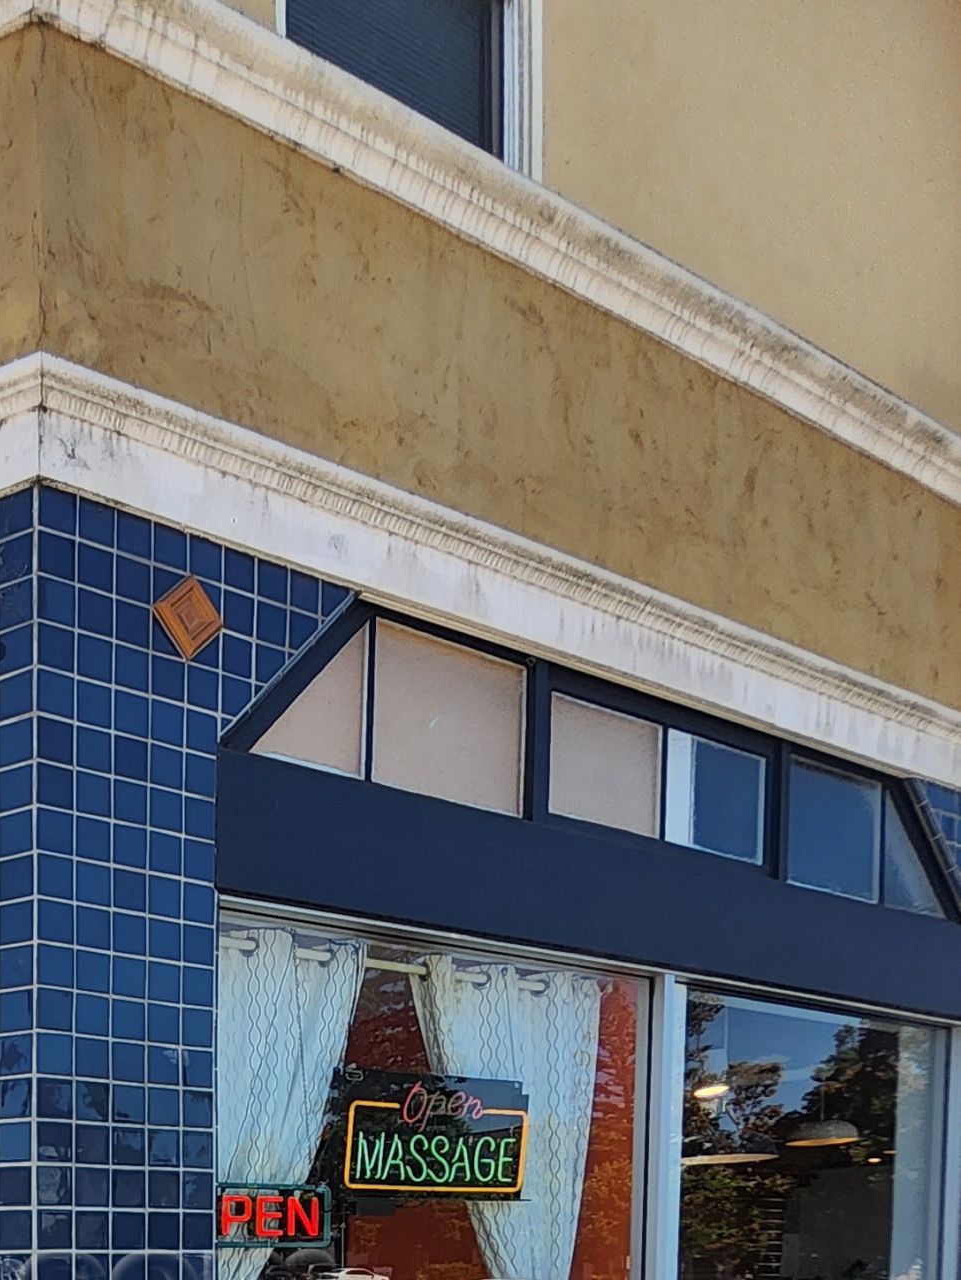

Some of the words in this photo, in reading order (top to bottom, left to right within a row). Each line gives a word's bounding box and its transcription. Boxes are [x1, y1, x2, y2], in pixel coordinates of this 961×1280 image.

[403, 1081, 484, 1132] Open
[355, 1130, 516, 1183] MASSAGE
[222, 1195, 319, 1237] PEN
